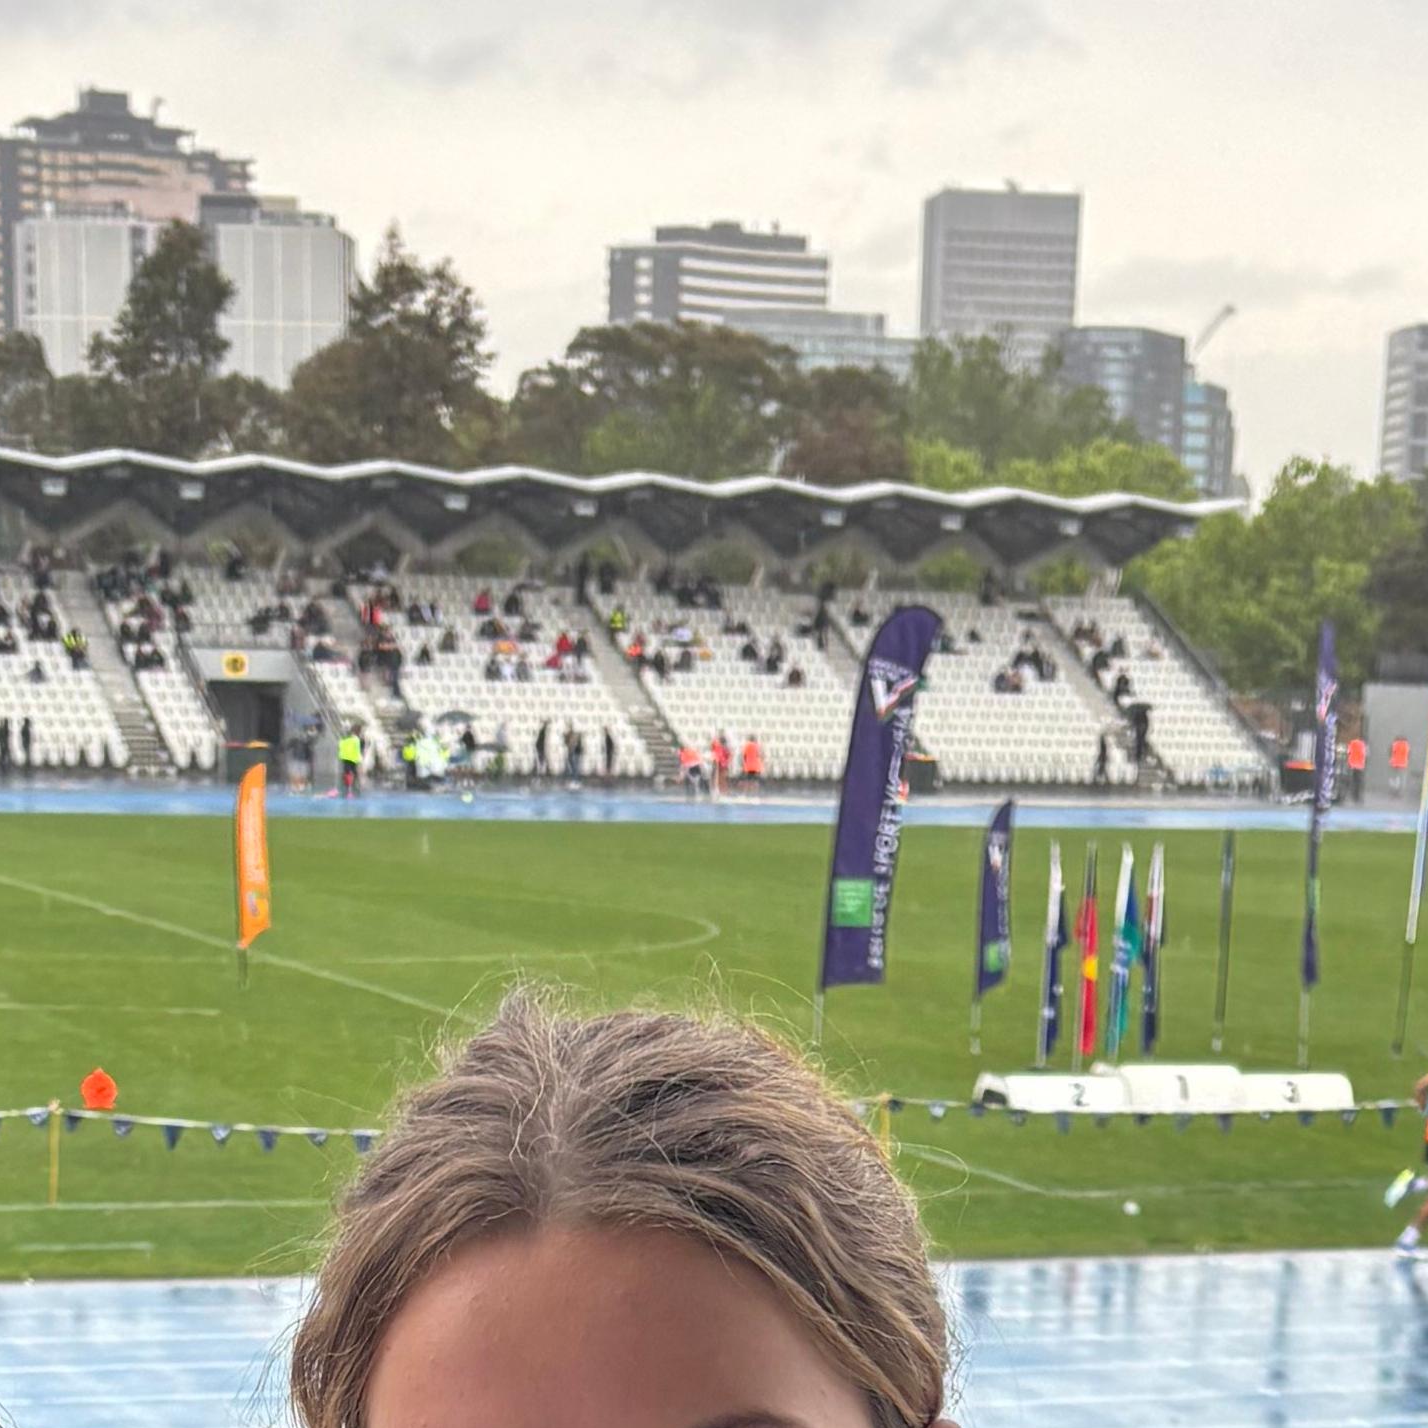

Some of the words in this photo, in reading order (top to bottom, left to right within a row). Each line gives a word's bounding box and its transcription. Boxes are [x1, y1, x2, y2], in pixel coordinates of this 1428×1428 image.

[1072, 1083, 1090, 1107] 2
[1176, 1075, 1189, 1101] 1
[1283, 1081, 1300, 1103] 3
